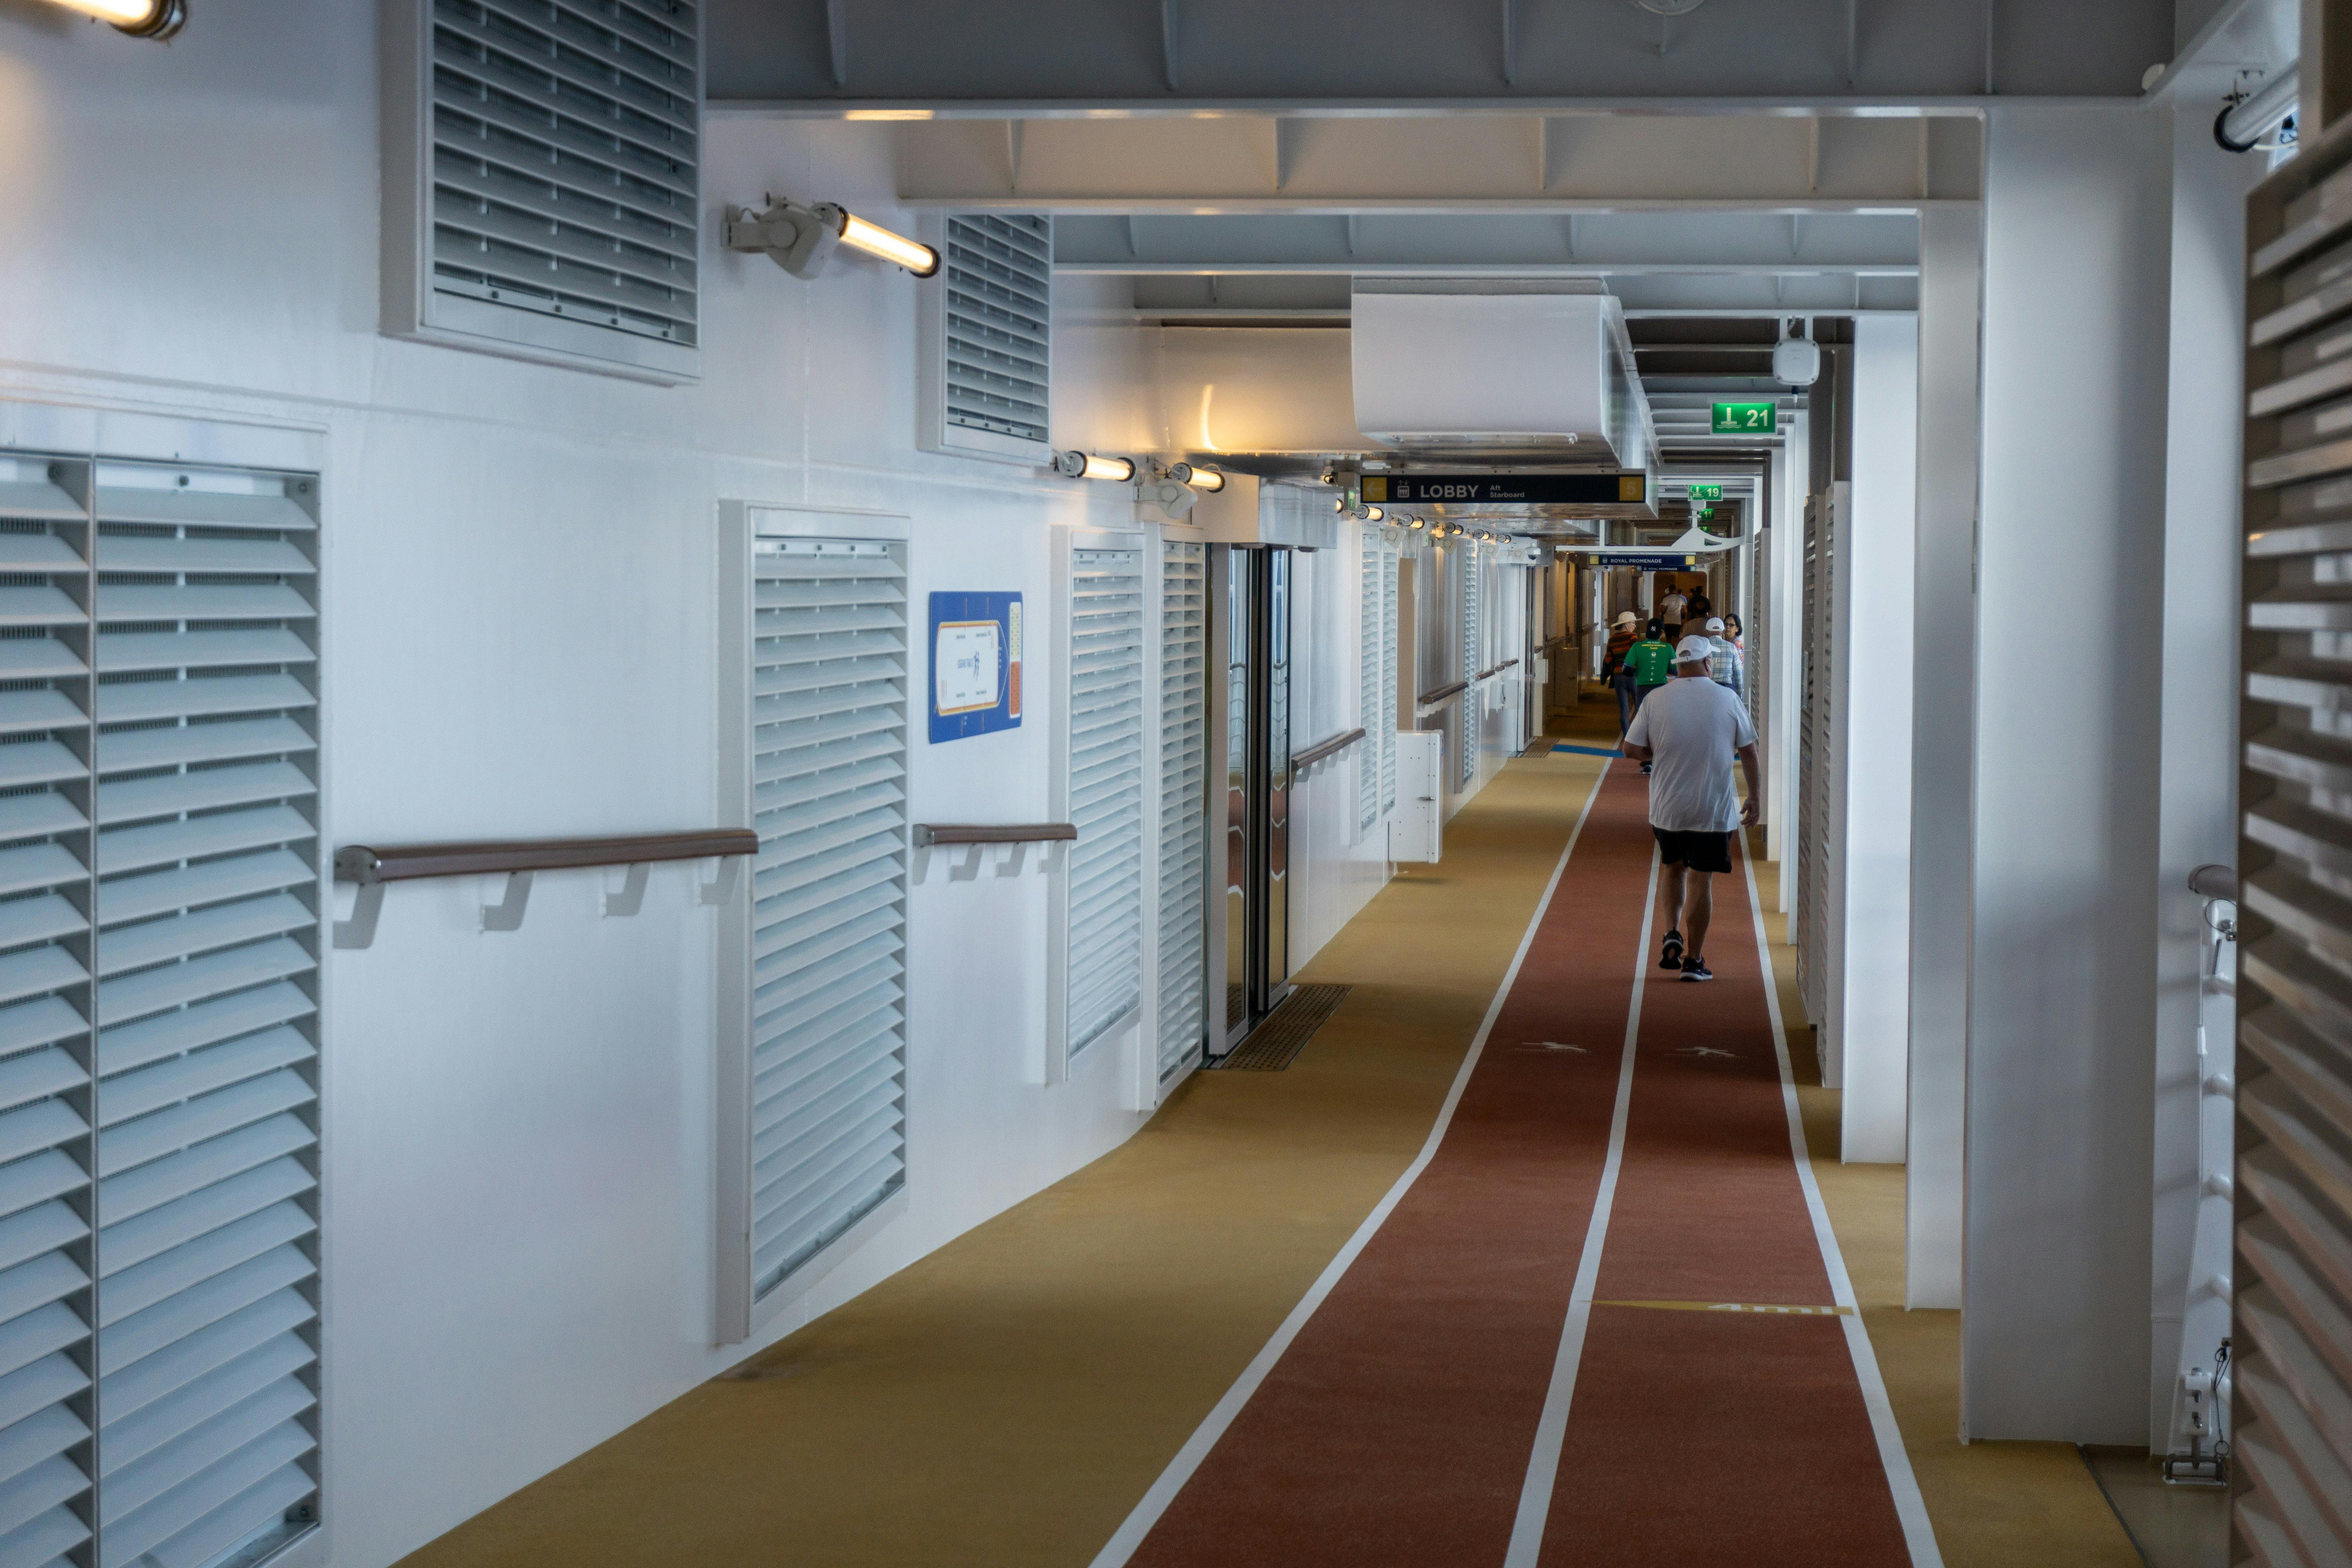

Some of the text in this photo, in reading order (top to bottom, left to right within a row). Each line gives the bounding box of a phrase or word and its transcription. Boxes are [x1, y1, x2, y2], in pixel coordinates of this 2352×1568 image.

[1746, 409, 1768, 426] 21
[1420, 485, 1479, 498] LOBBY
[1707, 488, 1719, 497] 19
